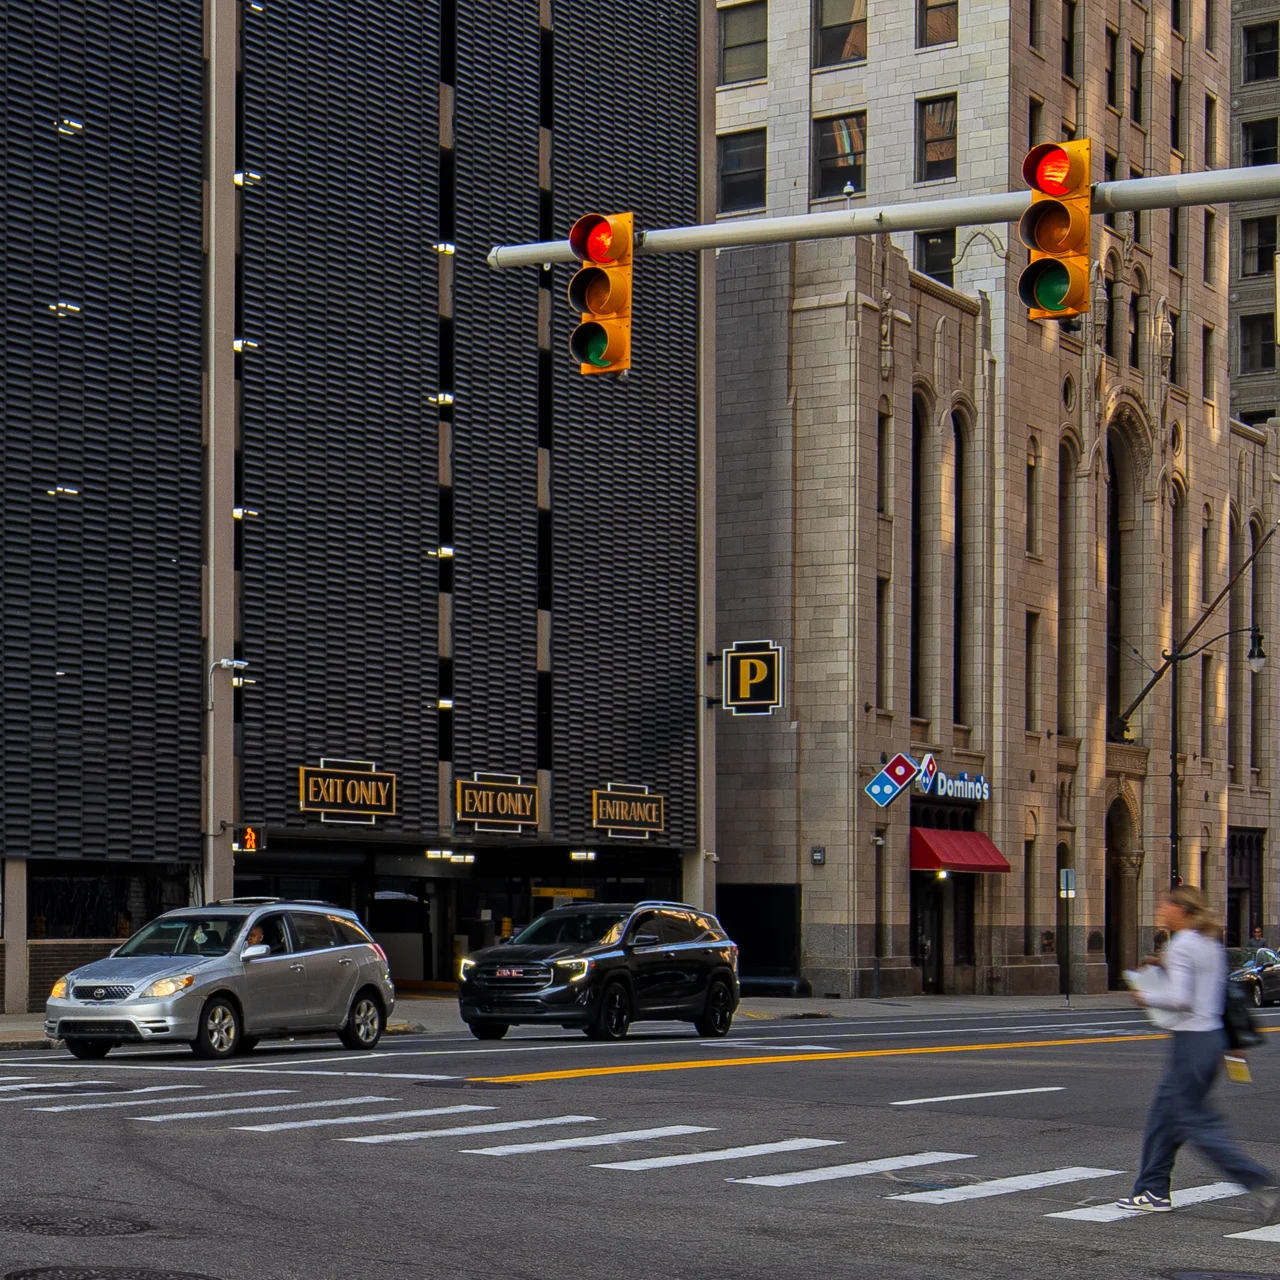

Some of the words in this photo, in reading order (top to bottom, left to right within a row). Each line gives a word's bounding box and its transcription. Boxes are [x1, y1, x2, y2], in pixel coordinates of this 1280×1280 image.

[739, 658, 768, 698] P
[309, 777, 344, 803] EXIT
[346, 780, 390, 806] ONLY
[937, 772, 989, 800] Domino's
[465, 789, 495, 814] EXIT
[497, 791, 533, 816] ONLY
[599, 799, 659, 823] ENTRANCE
